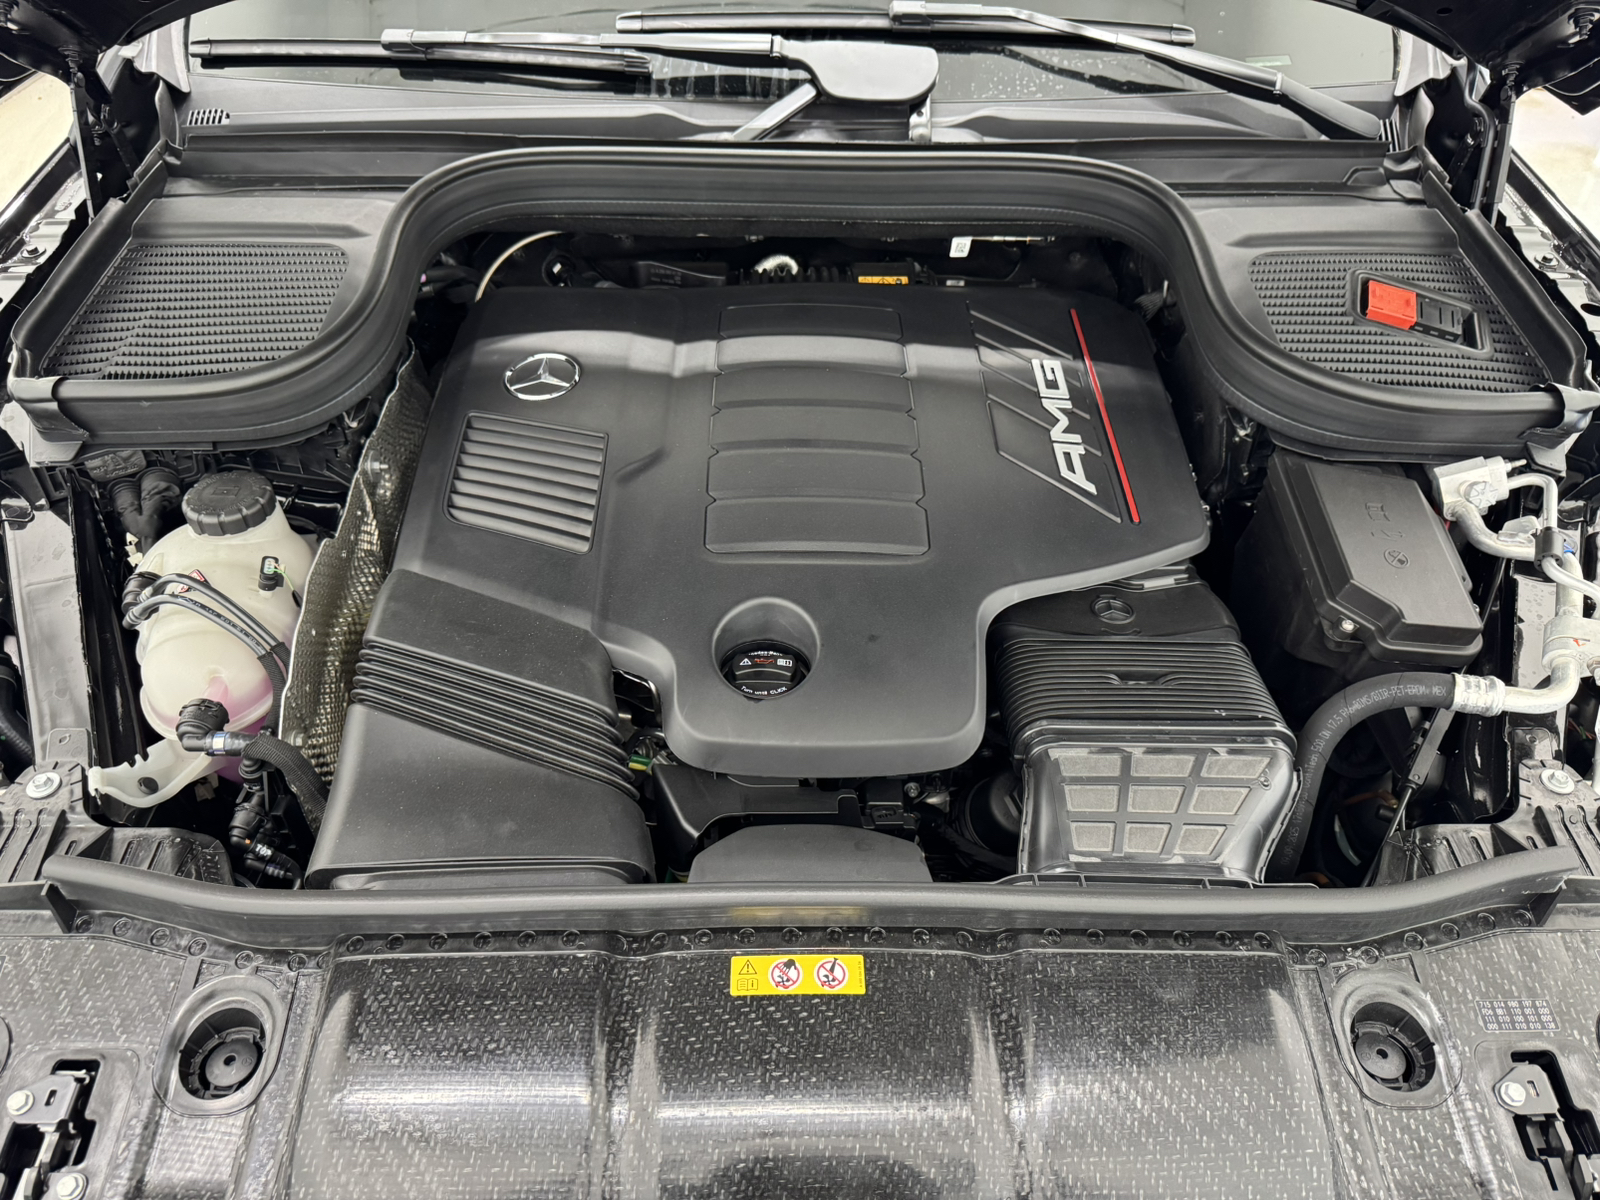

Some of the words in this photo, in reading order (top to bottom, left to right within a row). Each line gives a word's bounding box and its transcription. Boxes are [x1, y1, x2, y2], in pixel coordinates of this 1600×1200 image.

[1031, 358, 1098, 496] AMG
[741, 685, 753, 694] Turn
[769, 686, 788, 695] CLICK
[1310, 737, 1326, 753] 500
[1432, 685, 1447, 697] MEX
[255, 843, 272, 857] TOP
